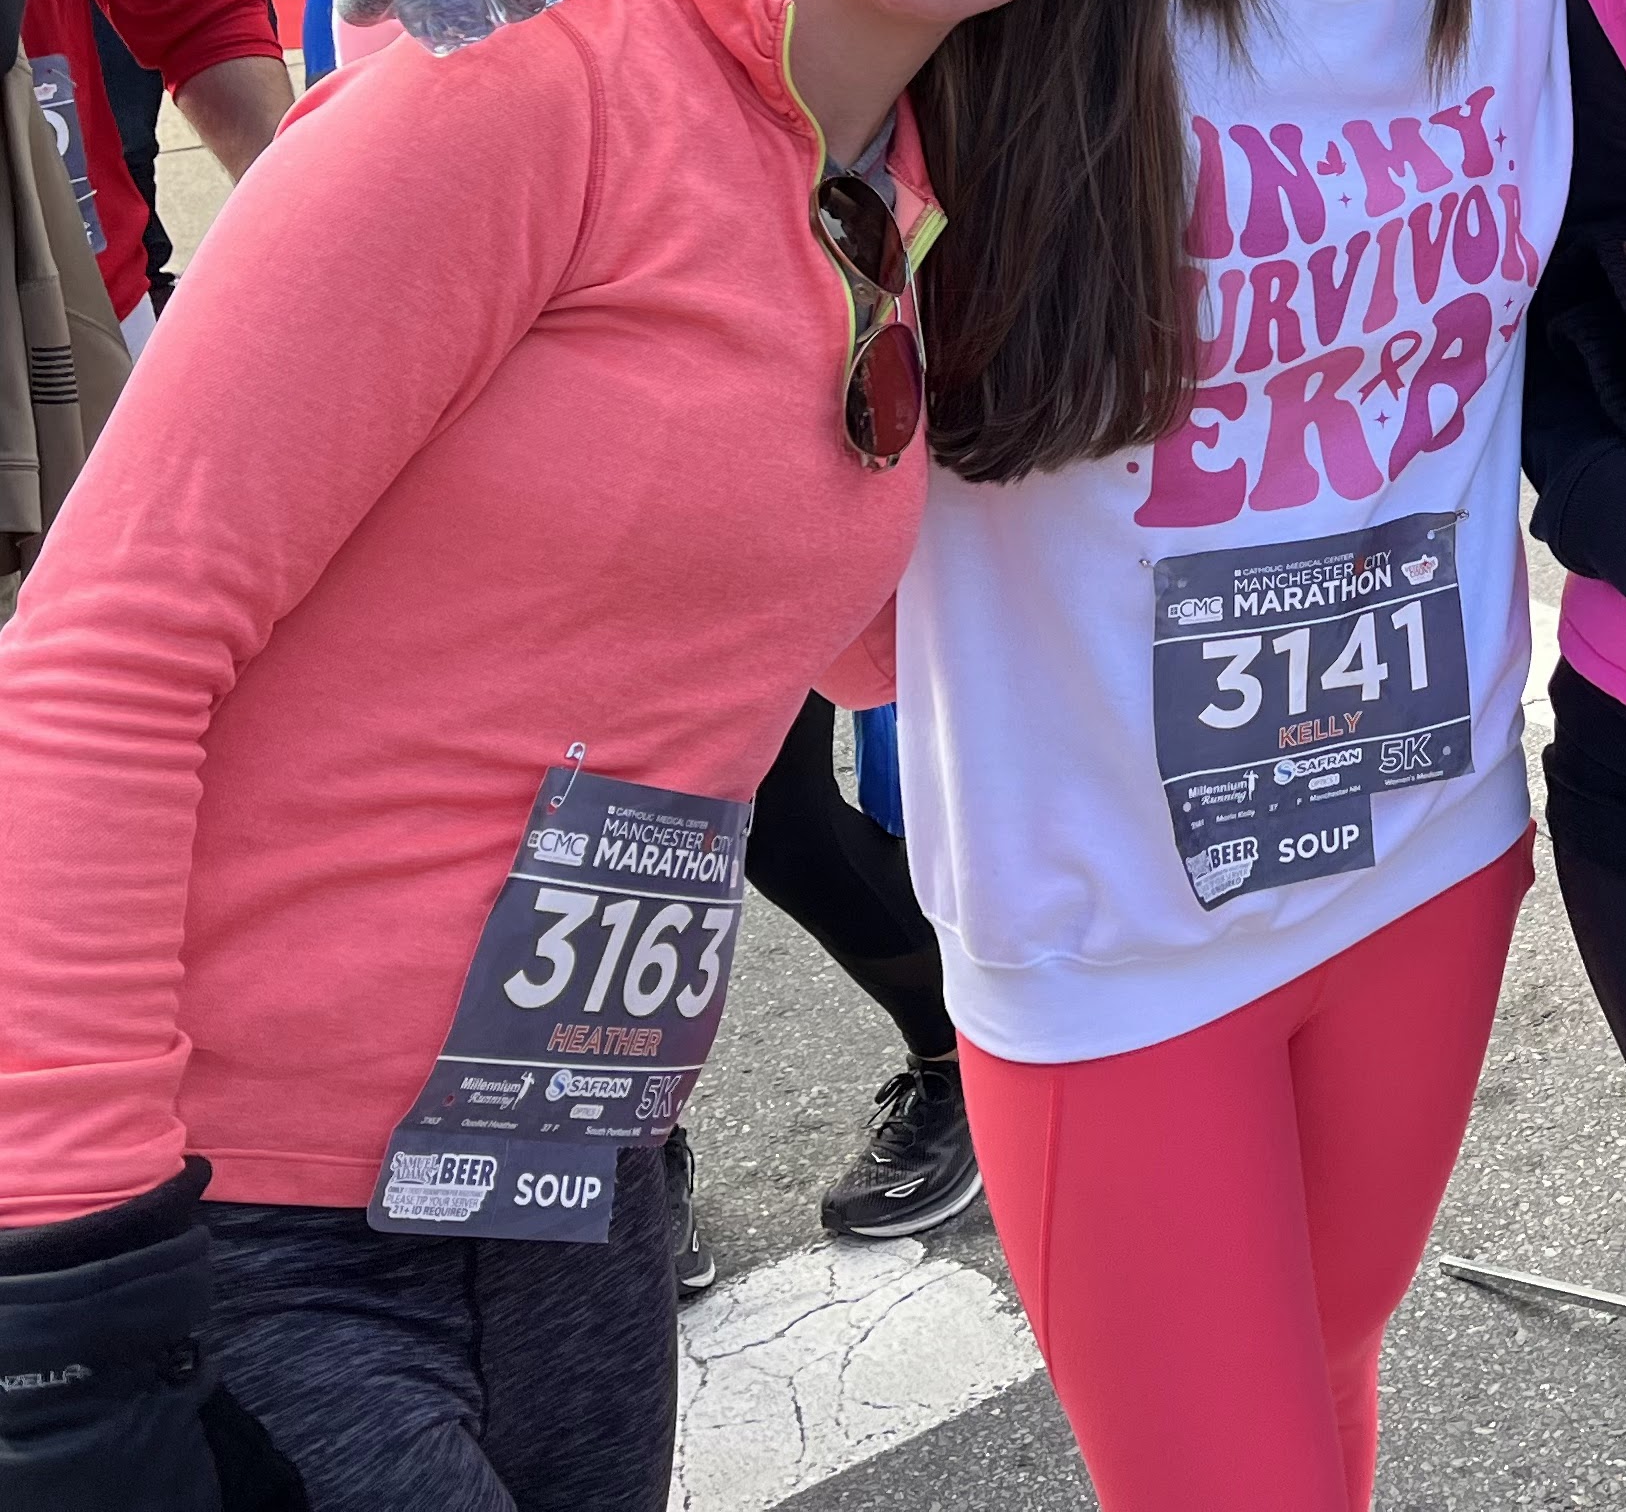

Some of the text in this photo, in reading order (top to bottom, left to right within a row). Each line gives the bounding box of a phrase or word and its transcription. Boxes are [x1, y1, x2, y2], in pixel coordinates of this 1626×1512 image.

[1182, 85, 1495, 259] IN MY
[1176, 184, 1540, 382] URVIVOR
[1134, 292, 1494, 528] ERA
[1233, 549, 1392, 593] MANCHESTER CITY
[1324, 552, 1355, 565] CENTER
[1179, 596, 1223, 618] CMC
[1233, 564, 1393, 618] MARATHON
[1197, 599, 1429, 730] 3141
[1277, 710, 1363, 749] KELLY
[1296, 748, 1361, 775] SAFRAN
[1378, 732, 1432, 774] 5K
[1188, 779, 1249, 799] Millennium
[1200, 787, 1248, 806] Running
[615, 807, 654, 822] CATHOLIC
[539, 830, 588, 858] CMC
[601, 818, 734, 854] MANCHESTER CITY
[1278, 823, 1360, 864] SOUP
[592, 837, 729, 883] MARATHON
[1210, 839, 1256, 869] BEER
[503, 887, 735, 1019] 3163
[546, 1023, 663, 1057] HEATHER
[460, 1076, 522, 1093] Millennium
[570, 1077, 632, 1098] SAFRAN
[635, 1074, 682, 1120] 5K
[467, 1092, 515, 1110] Running
[391, 1152, 439, 1171] SAMUEL
[440, 1156, 495, 1186] BEER
[386, 1194, 479, 1209] PLEASE TIP YOUR SERVER
[514, 1172, 602, 1209] SOUP
[392, 1204, 469, 1218] 21+ ID REQUIRED
